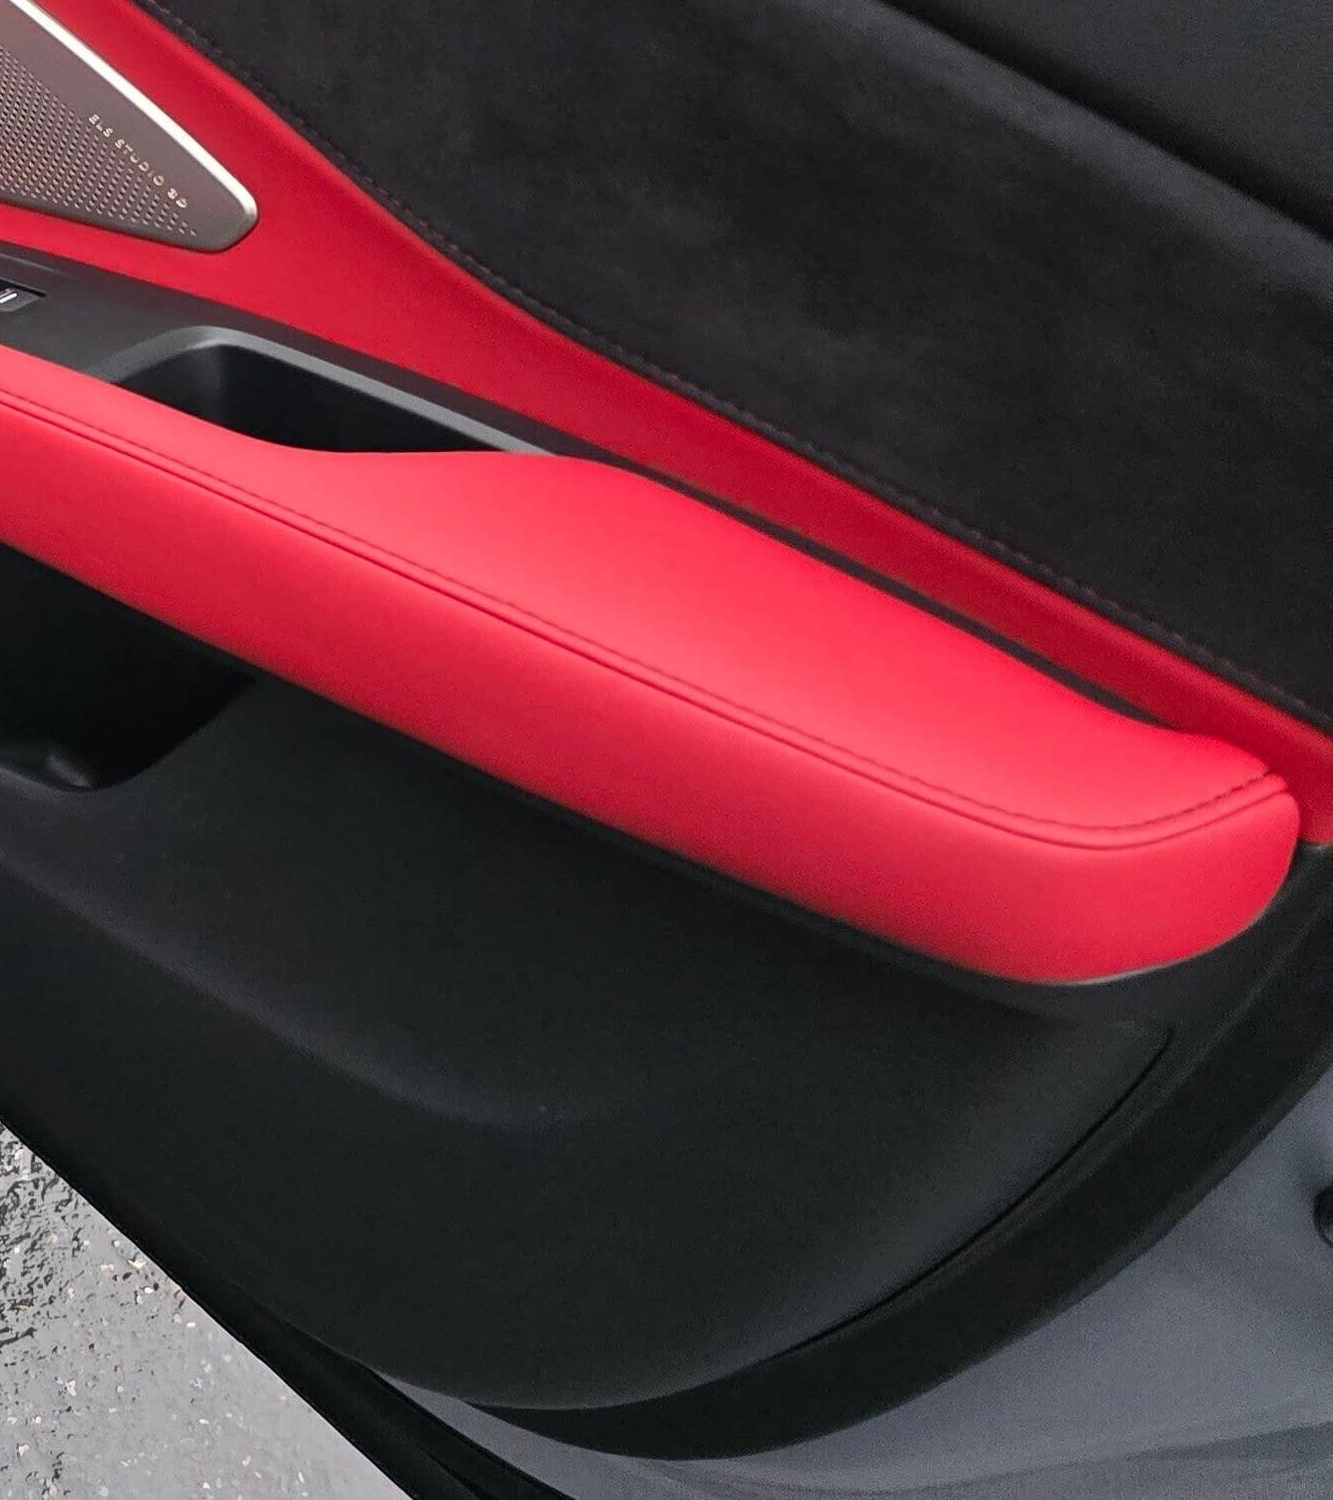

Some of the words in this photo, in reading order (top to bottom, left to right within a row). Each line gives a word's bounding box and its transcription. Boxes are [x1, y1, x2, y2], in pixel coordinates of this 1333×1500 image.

[88, 114, 114, 138] ELS
[114, 138, 165, 187] STUDIO
[167, 187, 188, 209] 3D
